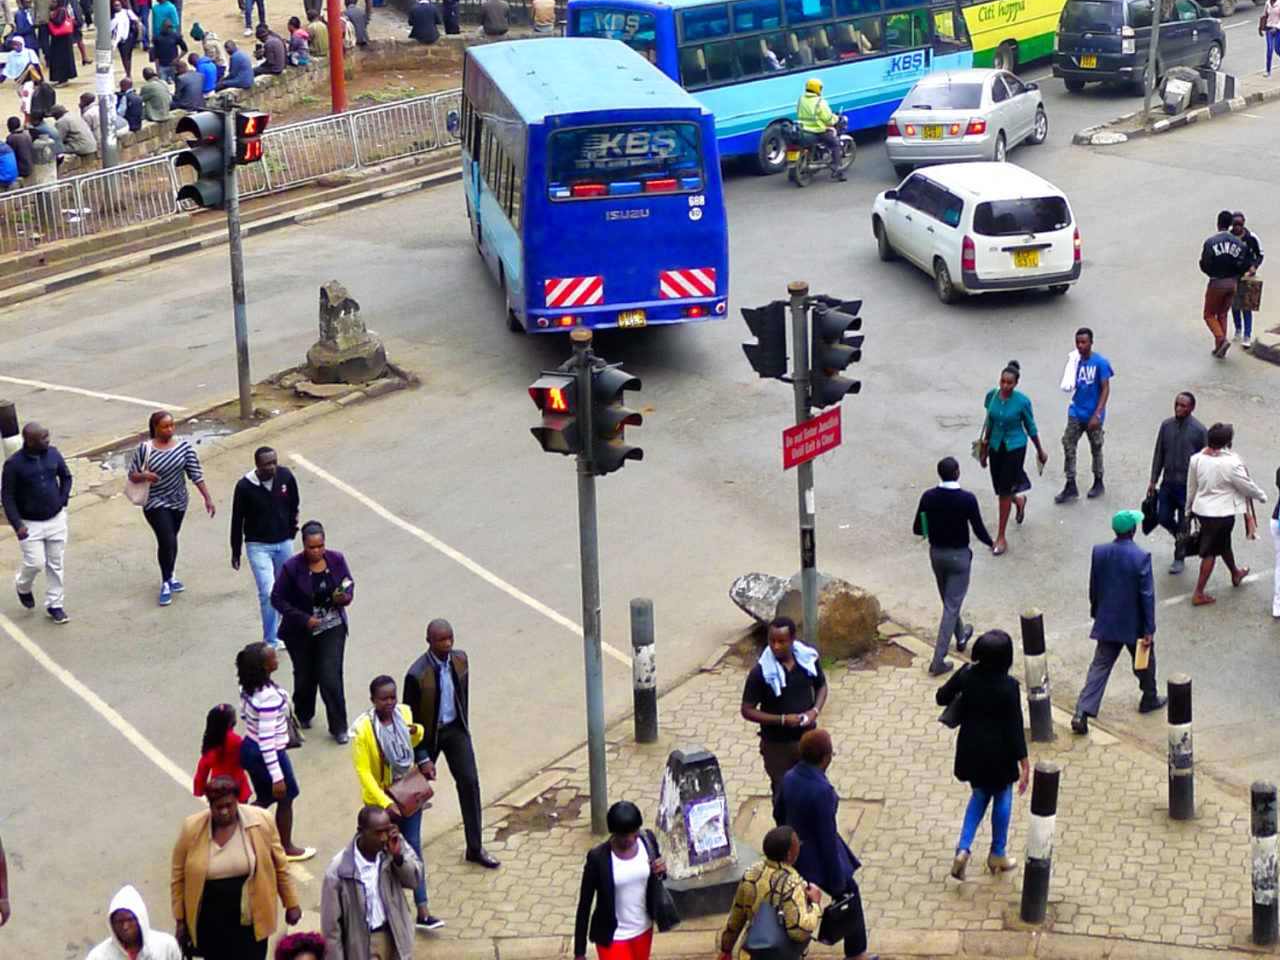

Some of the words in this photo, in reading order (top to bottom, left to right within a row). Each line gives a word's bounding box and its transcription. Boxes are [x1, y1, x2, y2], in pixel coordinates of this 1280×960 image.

[978, 4, 995, 22] Citi
[998, 0, 1025, 22] hoppa
[890, 52, 923, 72] KBS
[597, 129, 677, 157] KBS
[605, 208, 650, 222] ISUZU
[1212, 242, 1242, 258] KINGS
[785, 436, 793, 448] Do
[794, 431, 803, 444] not
[803, 427, 818, 440] Enter
[818, 415, 839, 433] Junction
[822, 432, 835, 446] Clear
